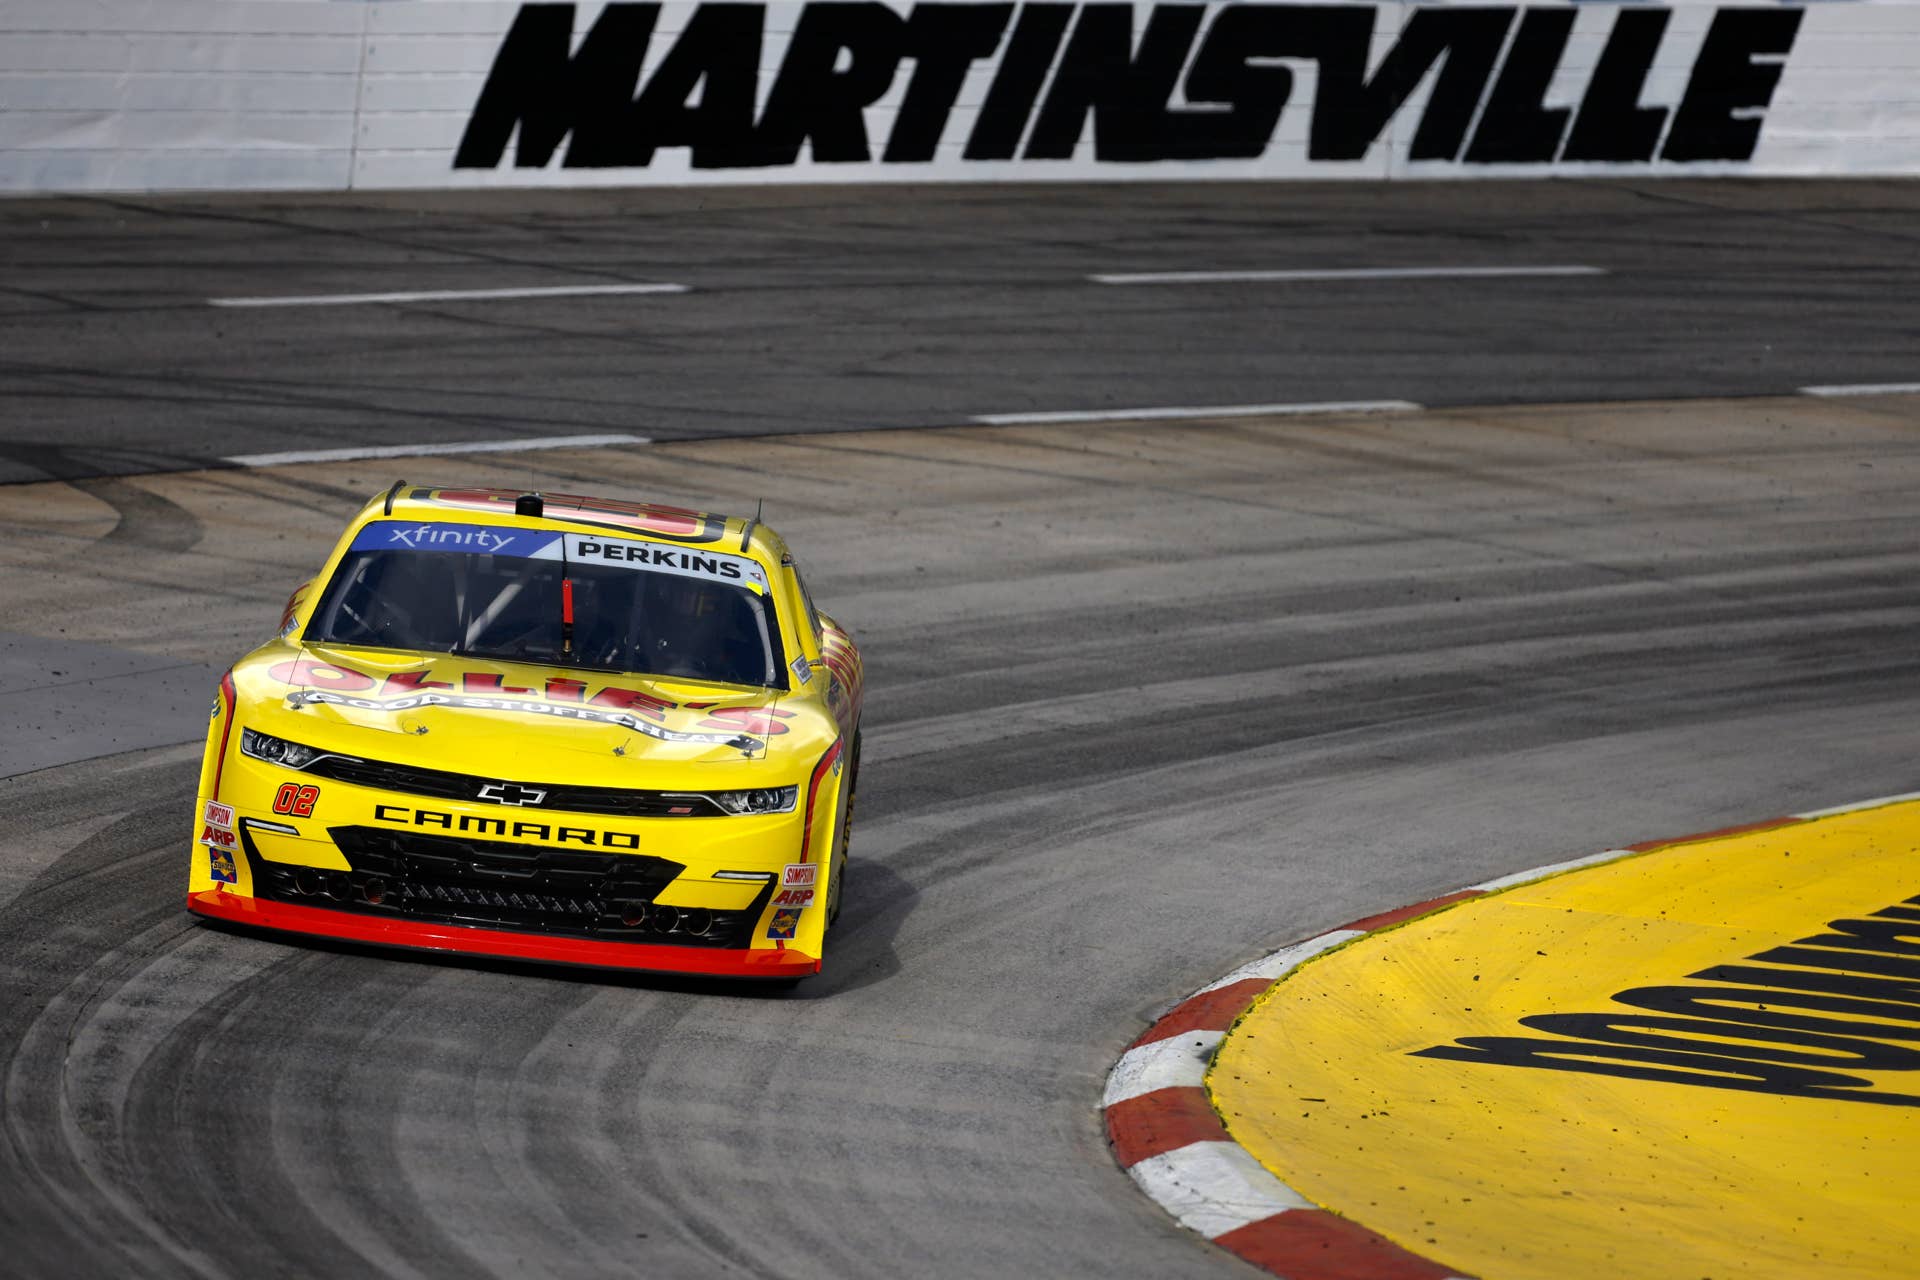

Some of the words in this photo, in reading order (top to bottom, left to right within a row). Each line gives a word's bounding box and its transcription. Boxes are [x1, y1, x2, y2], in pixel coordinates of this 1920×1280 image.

[453, 3, 1804, 170] MARTINSVILLE
[389, 525, 516, 552] xfinity
[578, 541, 741, 579] PERKINS
[463, 696, 602, 719] STUFF
[272, 782, 321, 818] 02
[206, 803, 232, 826] SIMPSON
[374, 804, 641, 849] CAMARO
[201, 825, 236, 846] ARP
[785, 867, 815, 884] SIMPSON
[773, 889, 814, 906] ARP
